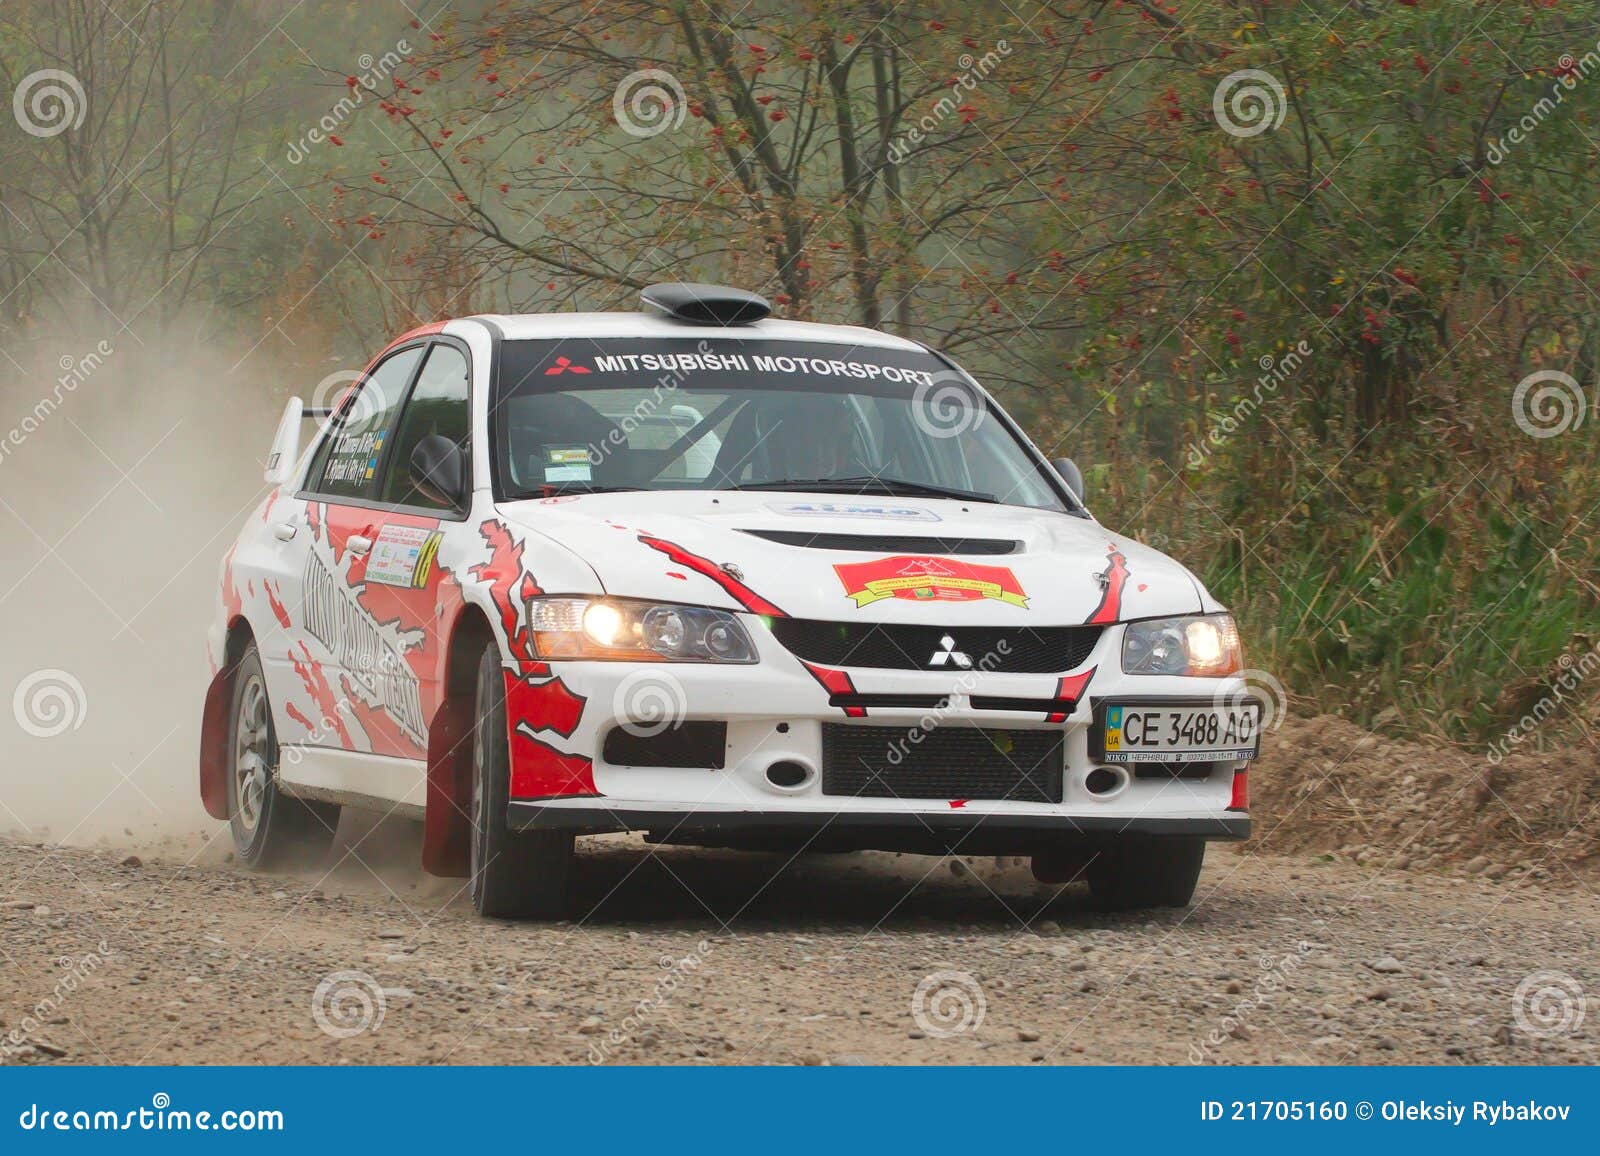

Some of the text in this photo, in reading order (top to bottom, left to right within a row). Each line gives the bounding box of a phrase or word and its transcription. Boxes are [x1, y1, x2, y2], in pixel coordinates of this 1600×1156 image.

[594, 353, 934, 387] MITSUBISHI MOTORSPORT
[1124, 712, 1161, 746] CE
[1167, 711, 1218, 746] 3488
[1107, 735, 1120, 745] UA
[1105, 753, 1128, 762] NIKO
